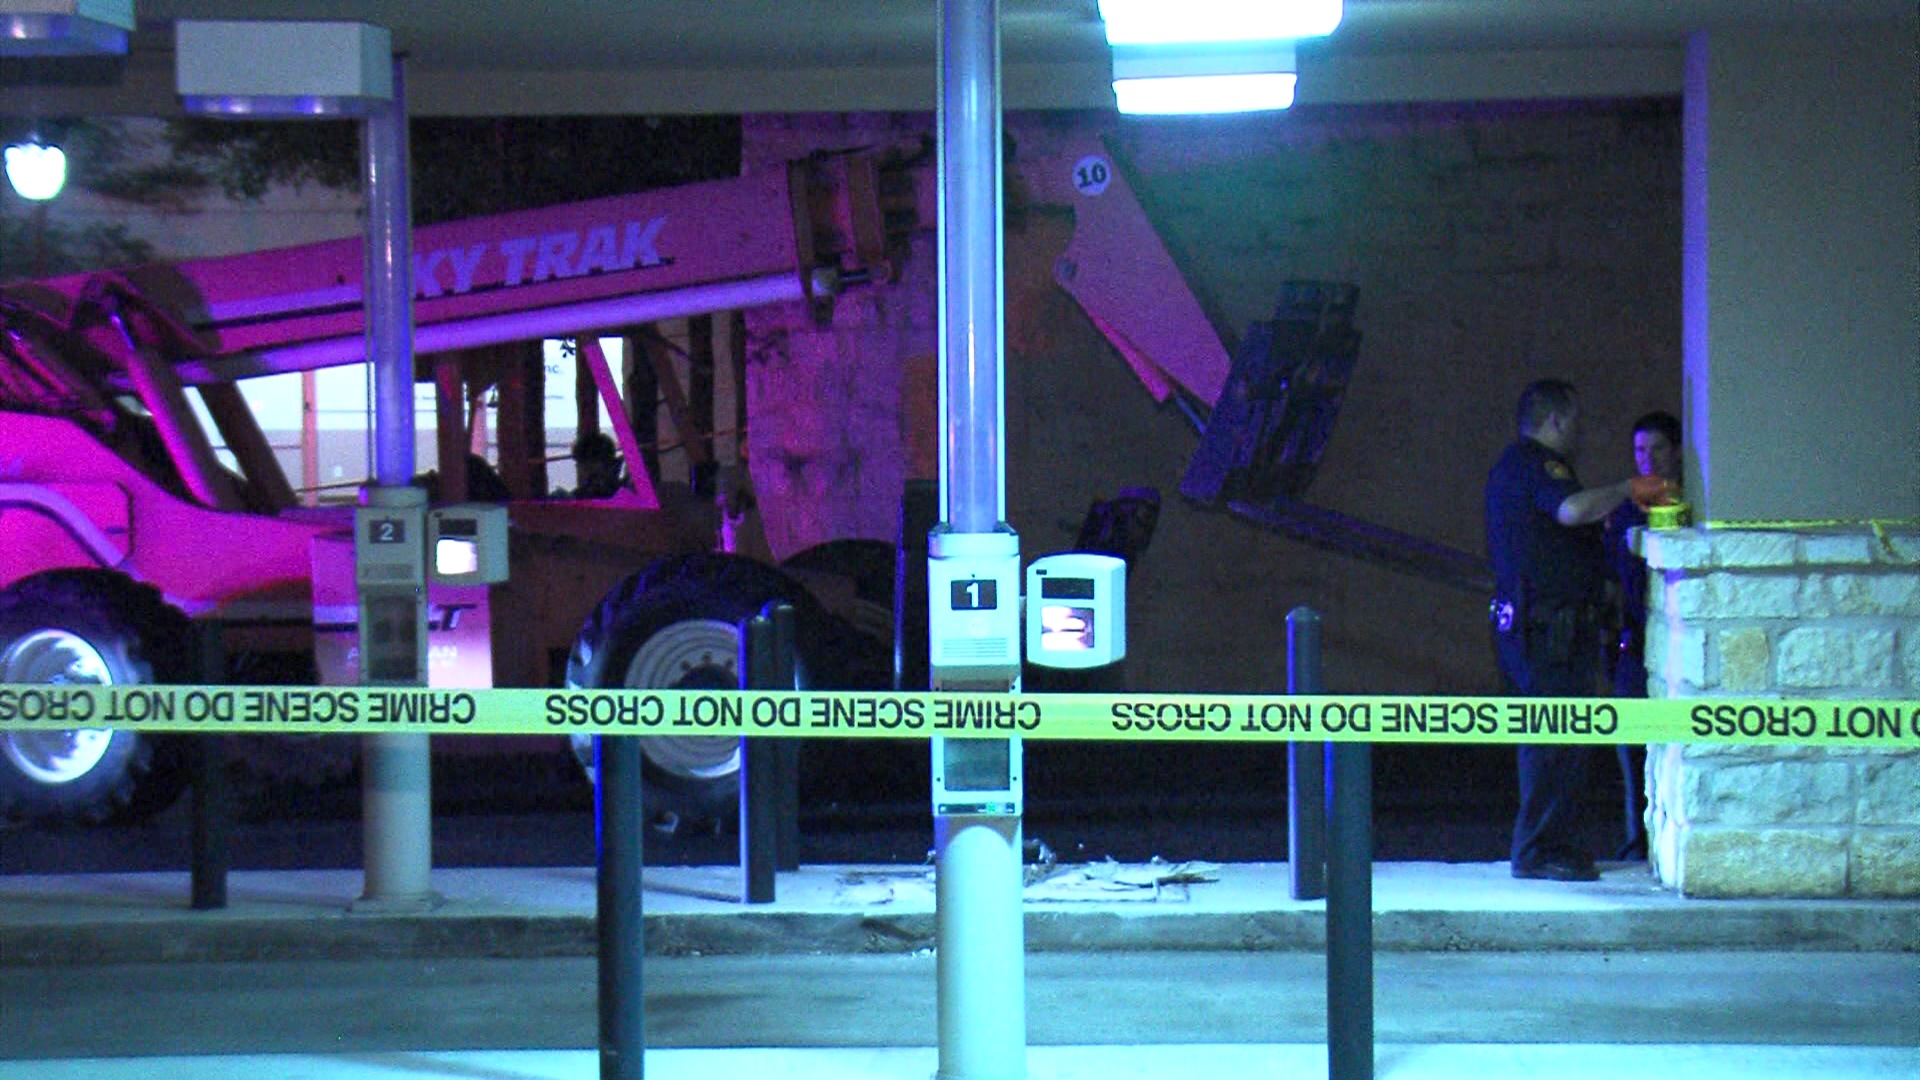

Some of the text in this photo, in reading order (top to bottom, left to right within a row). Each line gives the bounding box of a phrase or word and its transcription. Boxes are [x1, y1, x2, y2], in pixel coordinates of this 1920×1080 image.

[1077, 162, 1107, 189] 10
[413, 216, 667, 297] KY TRAK
[381, 522, 394, 542] 2
[965, 581, 980, 609] 1
[0, 690, 476, 724] CRIME SCENE DO NOT CROS
[545, 694, 1041, 730] CRIME SCENE DO NOT CROSS
[1111, 702, 1618, 735] CRIME SCENE DO NOT CROSS
[1691, 705, 1817, 737] CROSS
[1826, 707, 1901, 738] NOT
